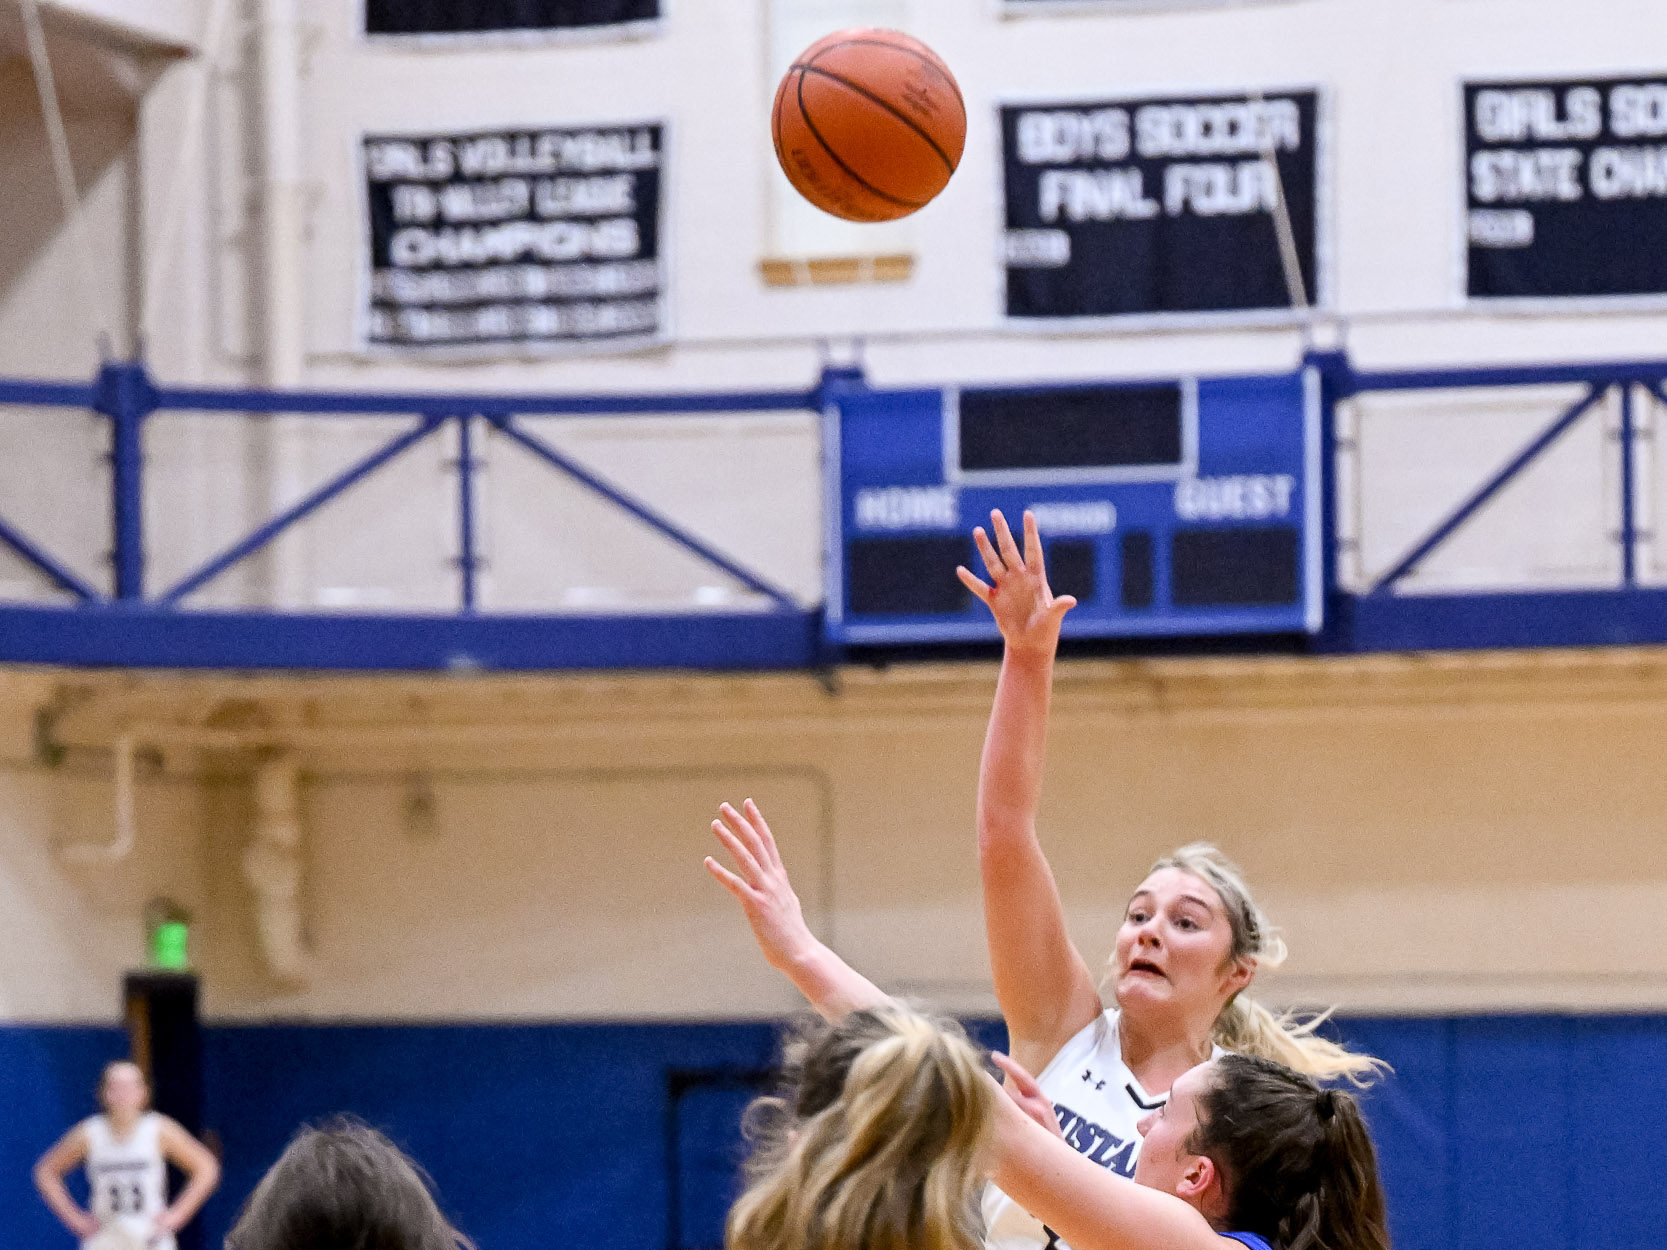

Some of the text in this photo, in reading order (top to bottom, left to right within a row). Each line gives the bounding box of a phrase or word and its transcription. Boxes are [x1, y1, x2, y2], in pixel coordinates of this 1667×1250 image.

[1016, 99, 1299, 164] BOYS SOCCER
[1474, 86, 1602, 142] GIRLS
[1037, 159, 1279, 223] FINAL FOUR
[1470, 146, 1667, 203] STATE CHA
[856, 486, 959, 529] HOME
[1175, 474, 1295, 520] GUEST
